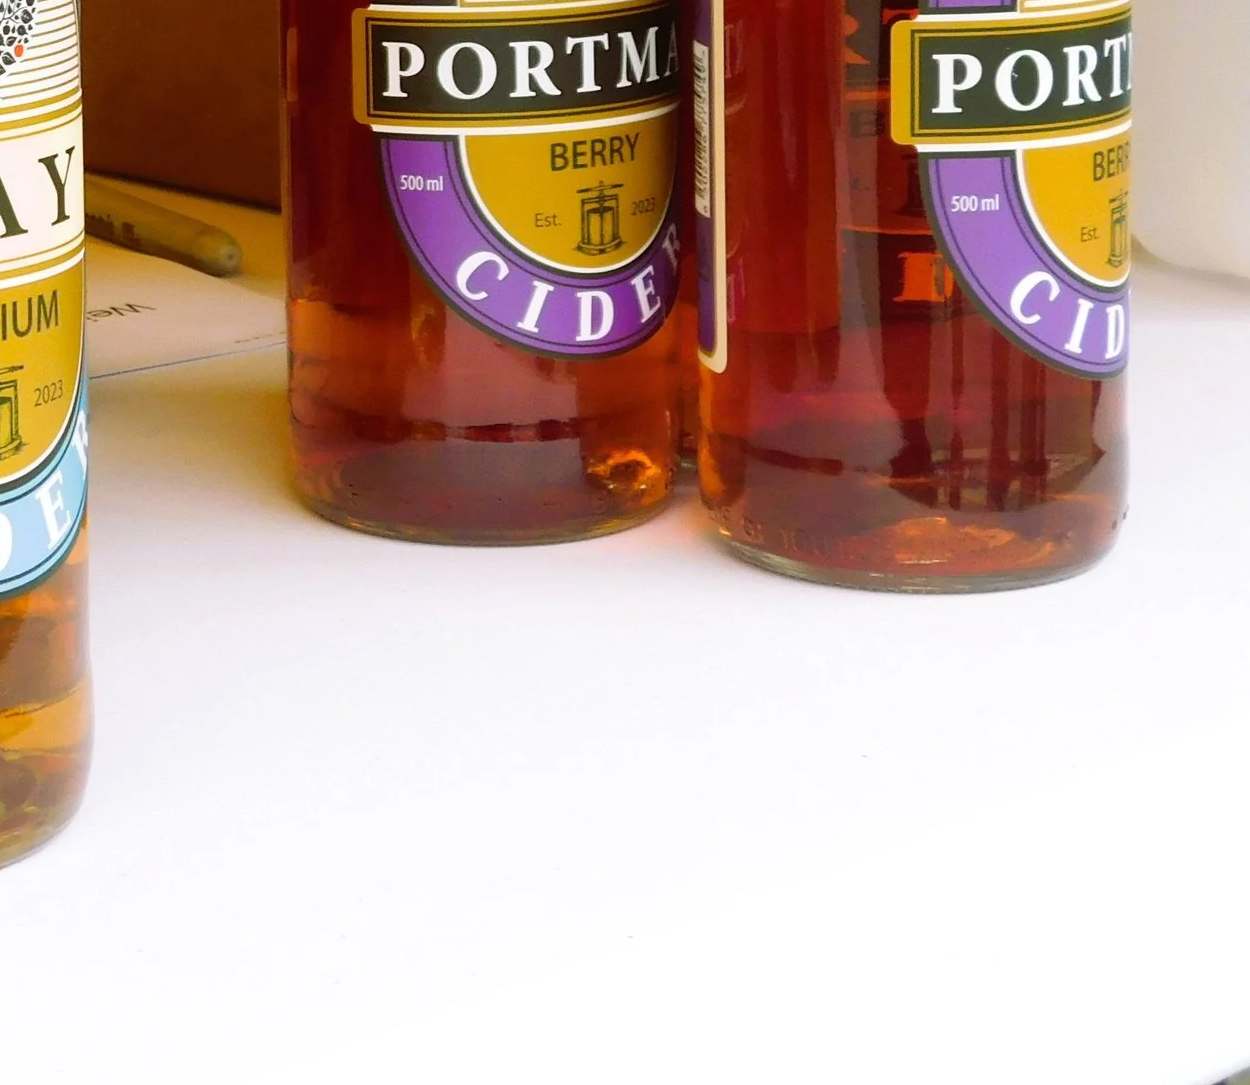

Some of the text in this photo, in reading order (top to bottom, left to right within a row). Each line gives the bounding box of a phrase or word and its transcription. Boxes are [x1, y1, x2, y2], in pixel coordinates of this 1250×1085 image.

[931, 32, 1132, 115] PORT
[549, 133, 640, 173] BERRY
[400, 174, 444, 192] 500 ml
[533, 196, 656, 230] Est. 2023
[950, 193, 1000, 212] 500 ml
[1080, 226, 1101, 244] Est.
[455, 222, 681, 343] CIDER
[1010, 270, 1125, 360] CID
[34, 379, 65, 408] 2023
